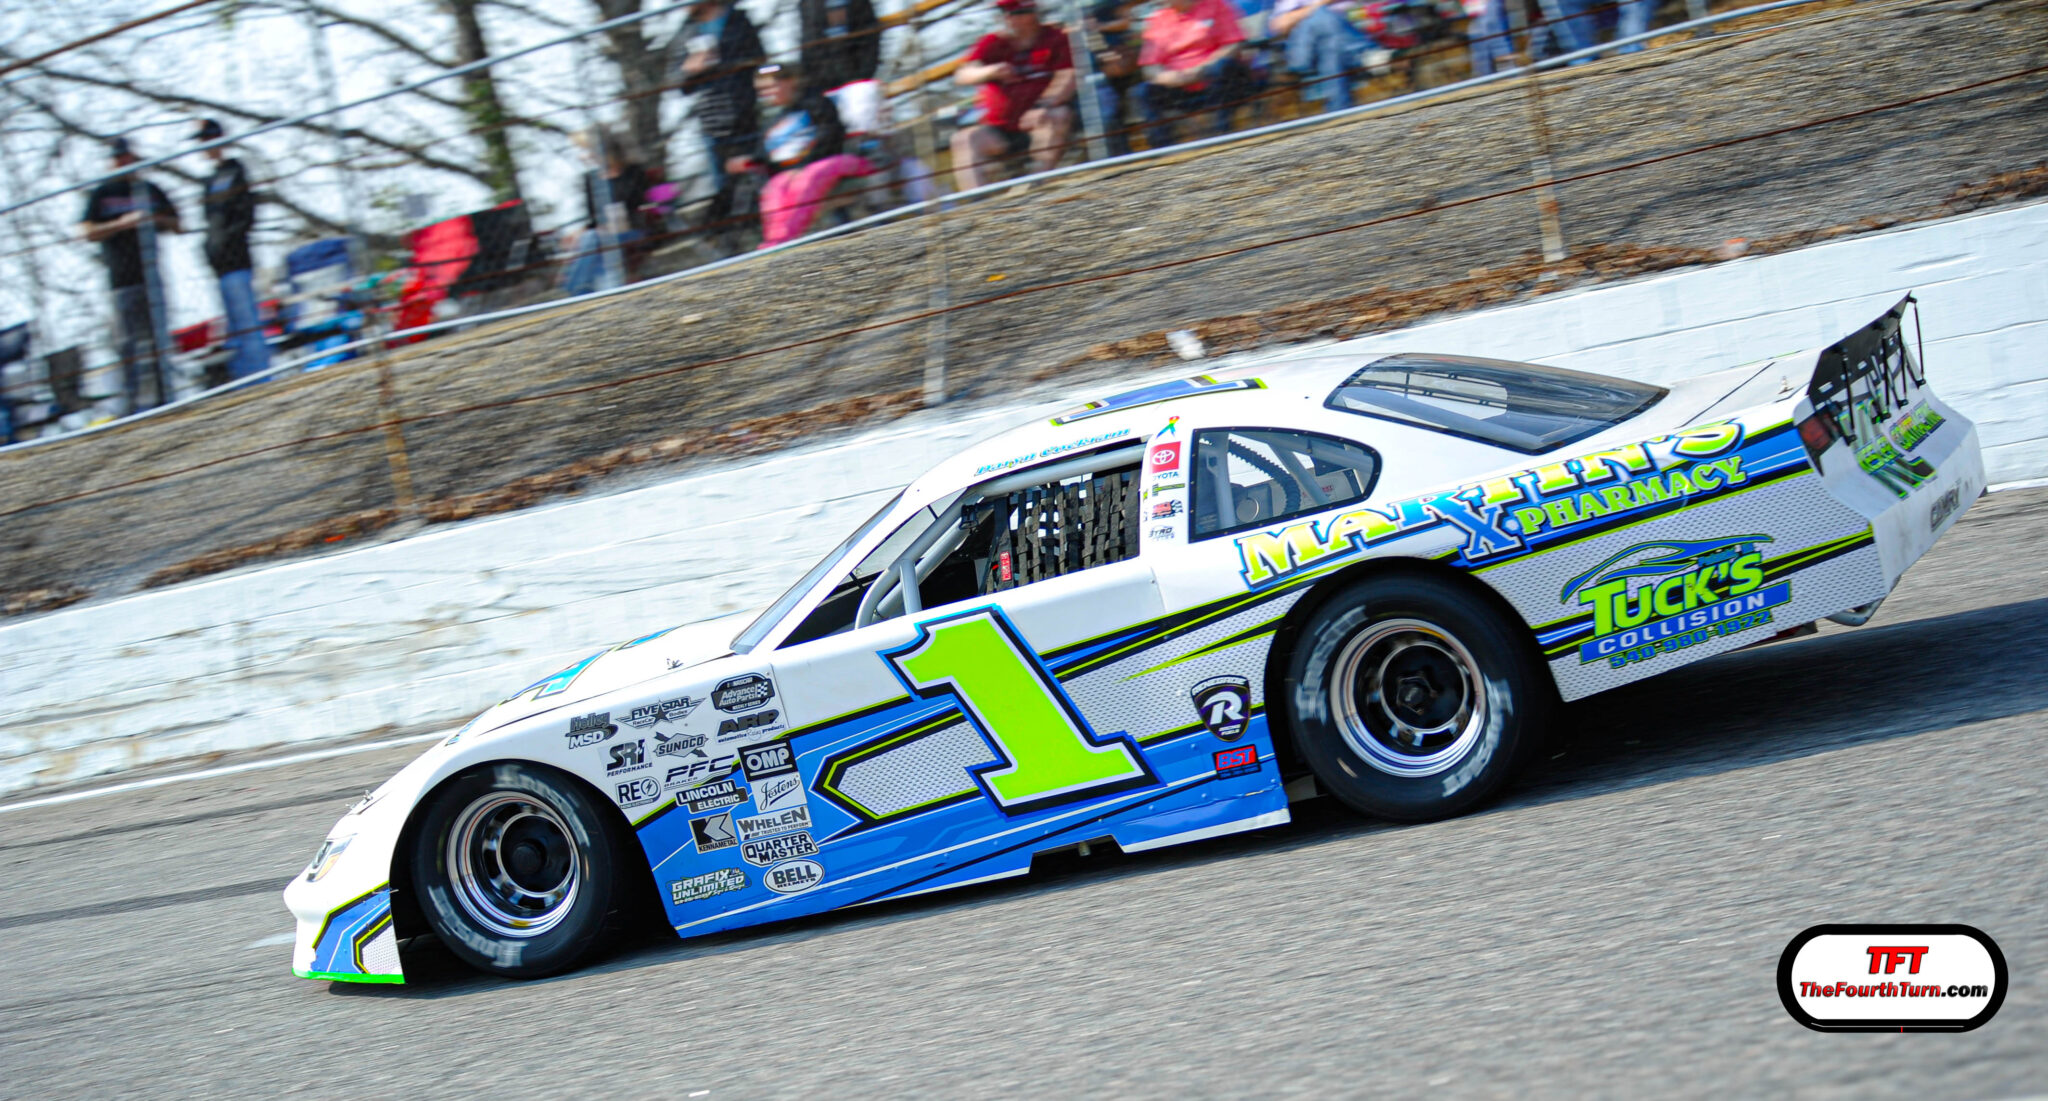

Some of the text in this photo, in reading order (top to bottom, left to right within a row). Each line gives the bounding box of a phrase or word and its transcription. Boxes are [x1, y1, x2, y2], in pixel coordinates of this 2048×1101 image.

[1235, 418, 1743, 584] MARTIN'S
[1513, 455, 1747, 535] PHARMACY
[1578, 552, 1763, 637] TUCK'S
[1598, 592, 1766, 655] COLLISION
[1609, 610, 1775, 669] 540-980-1922
[719, 693, 755, 707] Auto Parts
[721, 686, 755, 700] Advance
[631, 697, 691, 720] FIVE STAR
[892, 611, 1146, 807] 1
[1202, 691, 1247, 725] R
[717, 709, 780, 737] ARP
[569, 730, 605, 749] MSD
[659, 736, 704, 754] SUNOCO
[666, 755, 735, 783] PFC
[747, 748, 790, 771] OMP
[1217, 747, 1254, 769] BST
[606, 762, 653, 778] PERFORMANCE
[679, 782, 734, 803] LINCOLN
[697, 793, 741, 811] ELECTRIC
[760, 778, 800, 811] Jostens
[737, 806, 807, 833] WHELEN
[699, 839, 738, 851] KENNAMETAL
[745, 833, 809, 859] QUARTER
[758, 843, 814, 863] MASTER
[672, 869, 730, 892] GRAFIX
[772, 865, 817, 885] BELL
[673, 875, 745, 901] UNLIMITED
